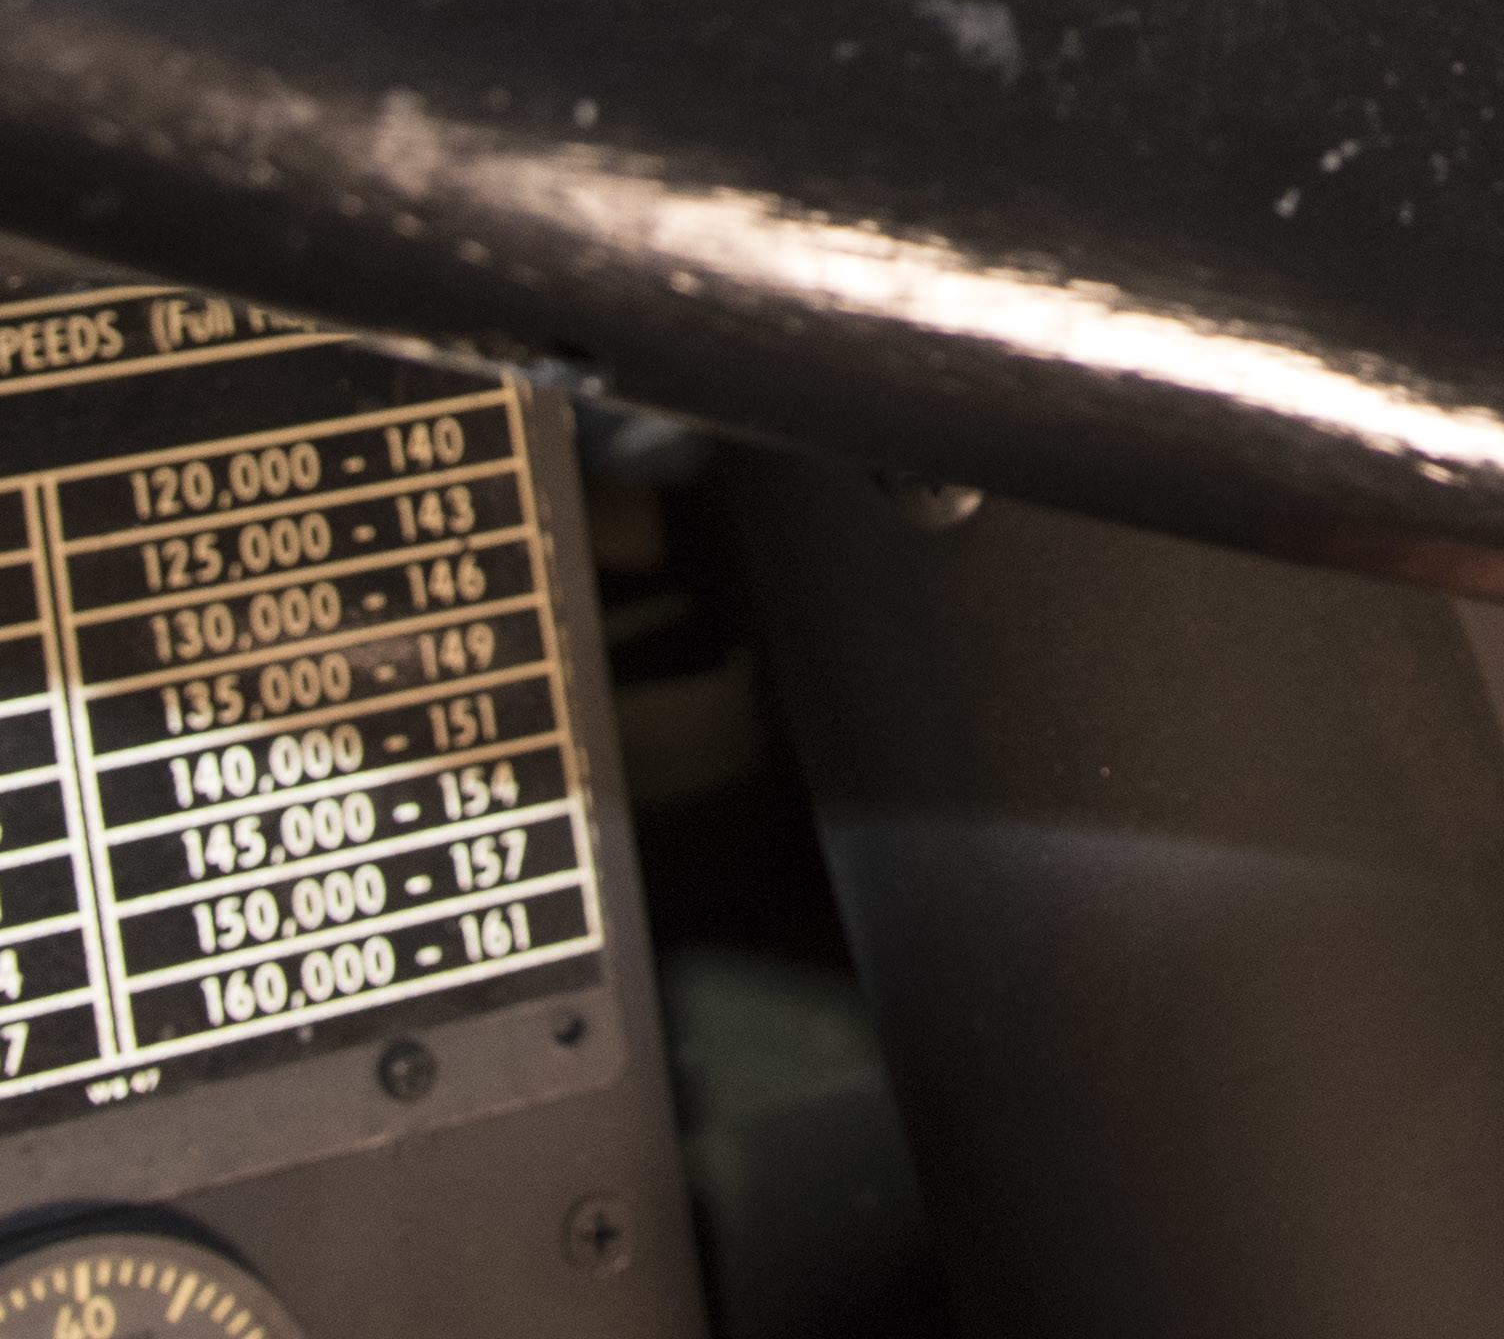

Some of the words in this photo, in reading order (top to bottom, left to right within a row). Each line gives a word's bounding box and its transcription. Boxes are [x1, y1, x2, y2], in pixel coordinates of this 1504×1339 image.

[130, 442, 322, 520] 120,000
[385, 416, 465, 472] 140
[142, 512, 332, 592] 125,000
[399, 486, 475, 541] 143
[151, 581, 341, 662] 130,000
[406, 554, 487, 611] 146
[160, 652, 351, 735] 135,000
[418, 623, 496, 679] 149
[171, 725, 364, 808] 140,000
[428, 694, 496, 751] 151
[182, 791, 376, 879] 145,000
[439, 761, 519, 821] 154
[193, 864, 386, 954] 150,000
[449, 829, 527, 891] 157
[201, 935, 395, 1026] 160,000
[460, 903, 530, 962] 161
